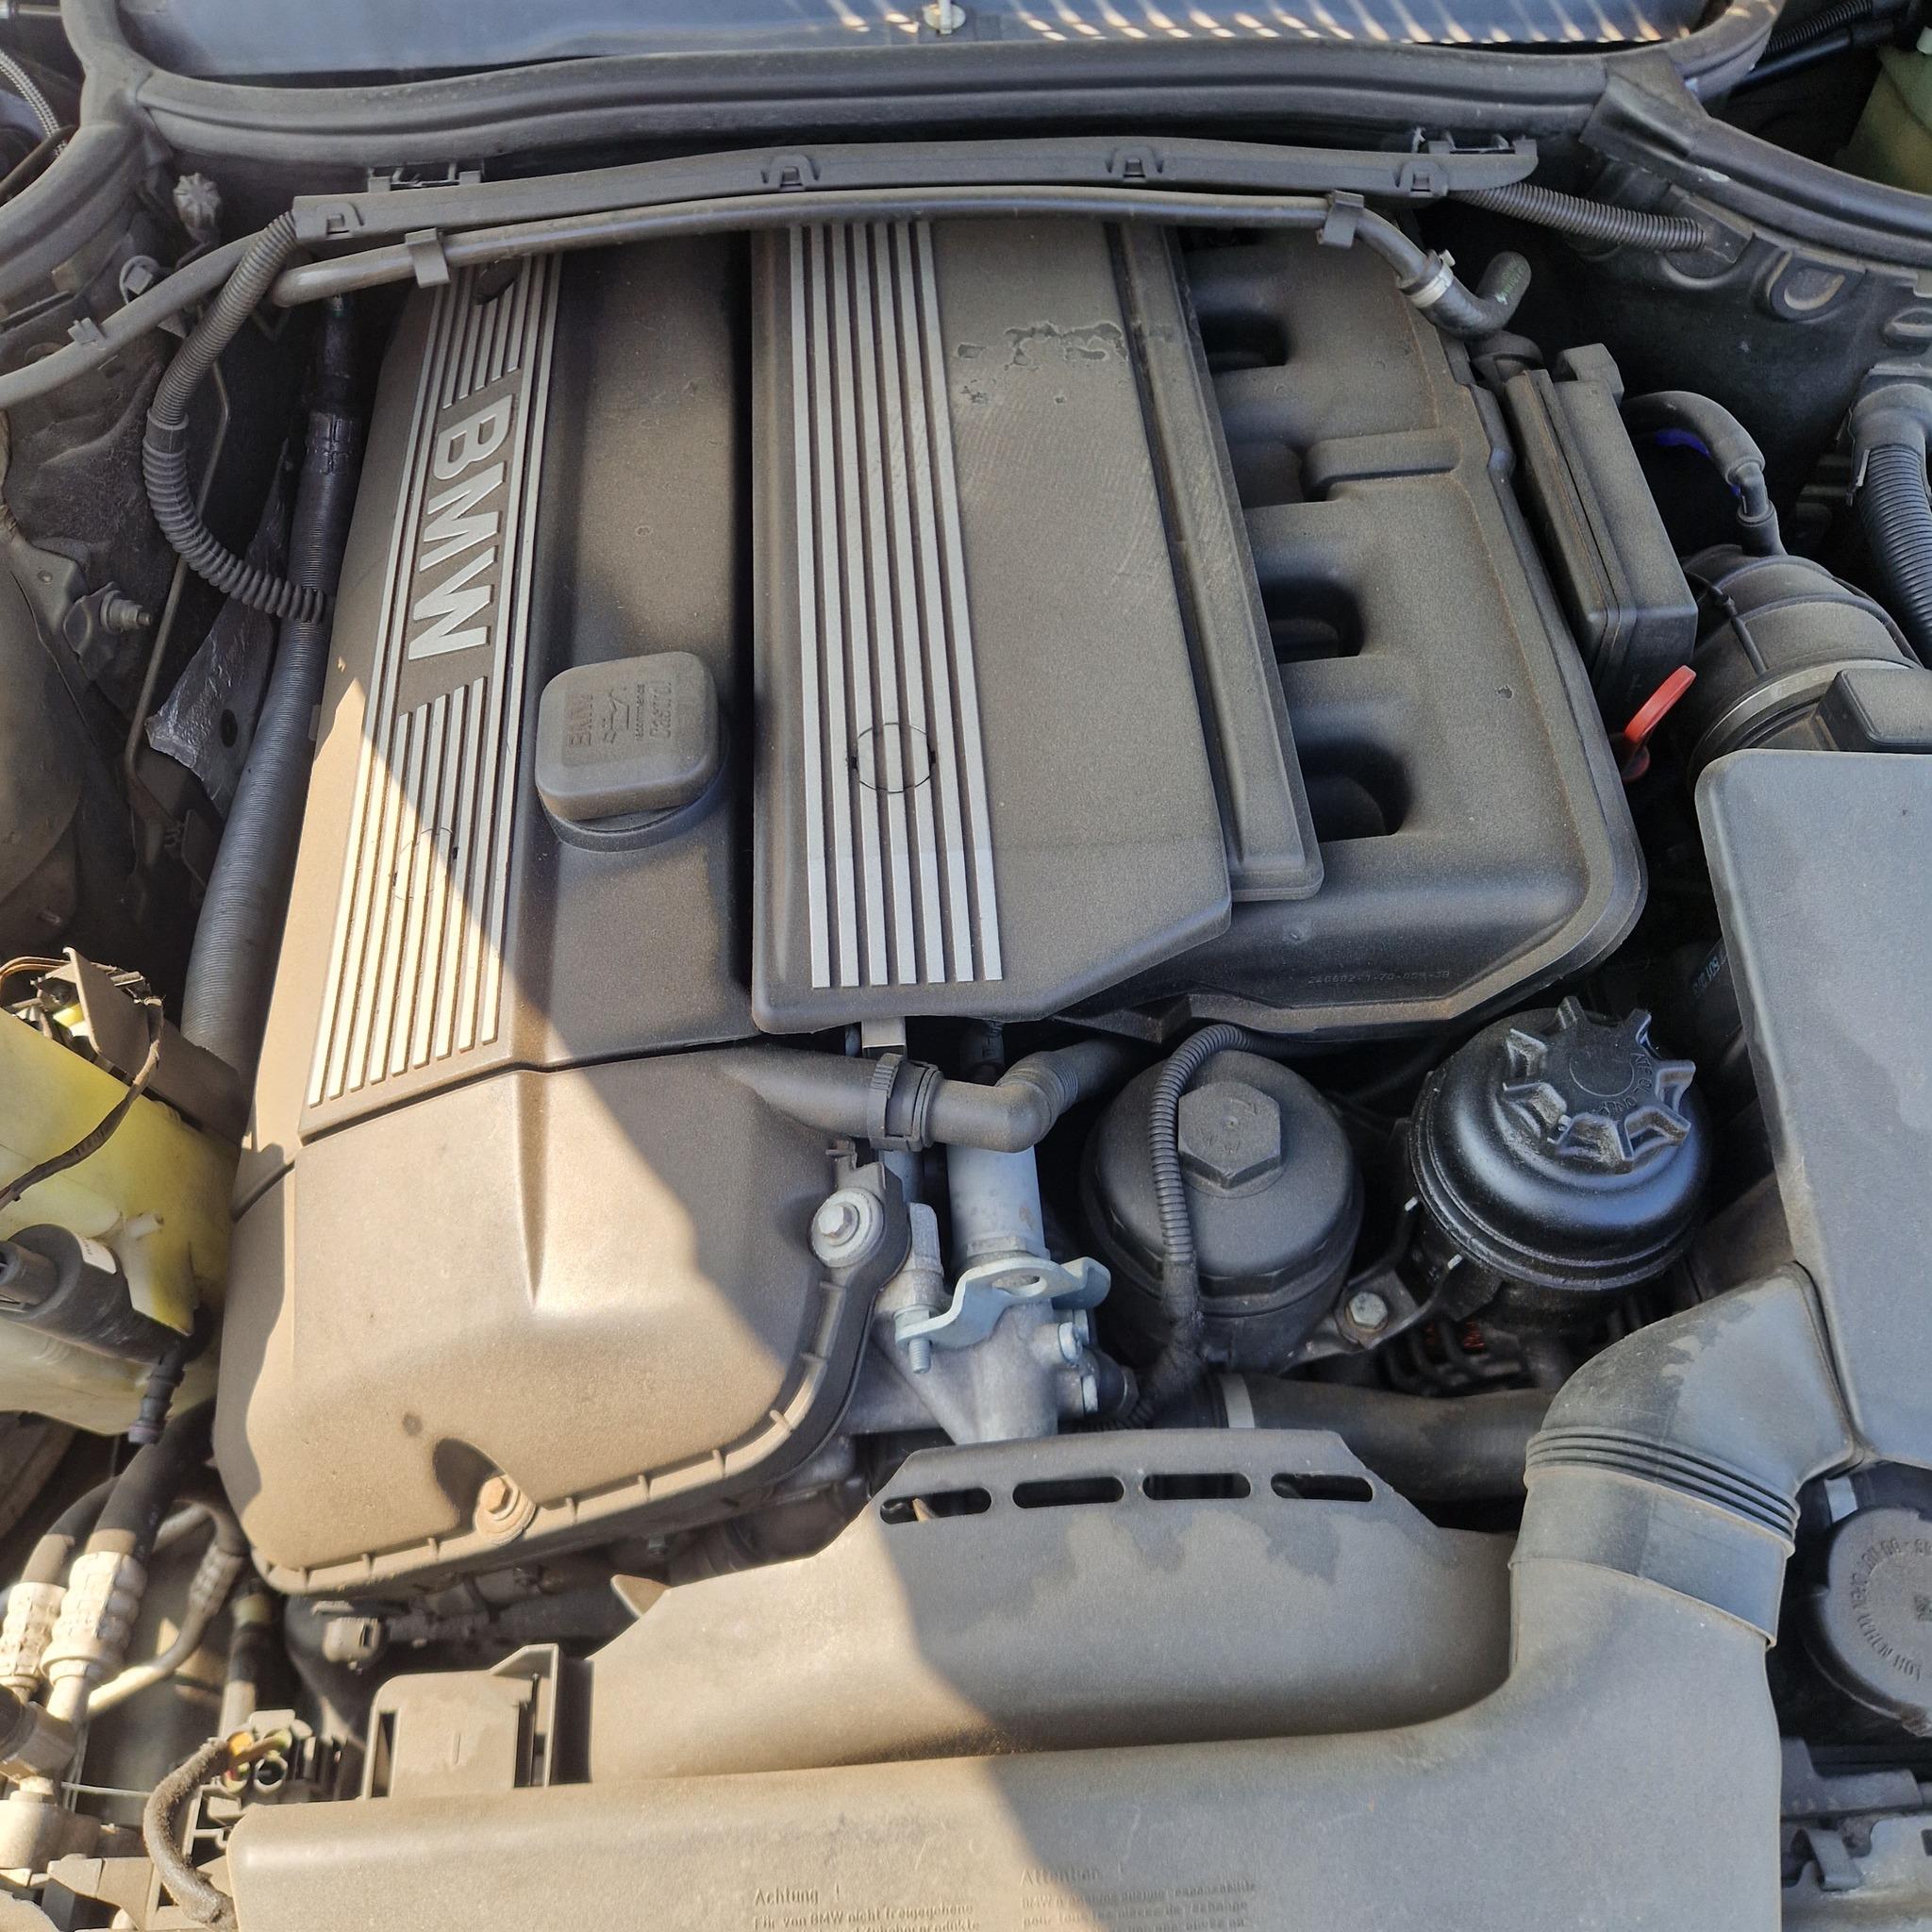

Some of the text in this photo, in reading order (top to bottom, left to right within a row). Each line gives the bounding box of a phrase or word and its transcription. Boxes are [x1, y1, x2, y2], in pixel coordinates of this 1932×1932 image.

[408, 393, 514, 660] BMW
[568, 693, 593, 747] BMW
[755, 1887, 818, 1906] Achtung
[782, 1916, 807, 1927] von
[809, 1909, 843, 1926] BMW
[848, 1907, 881, 1923] nicht
